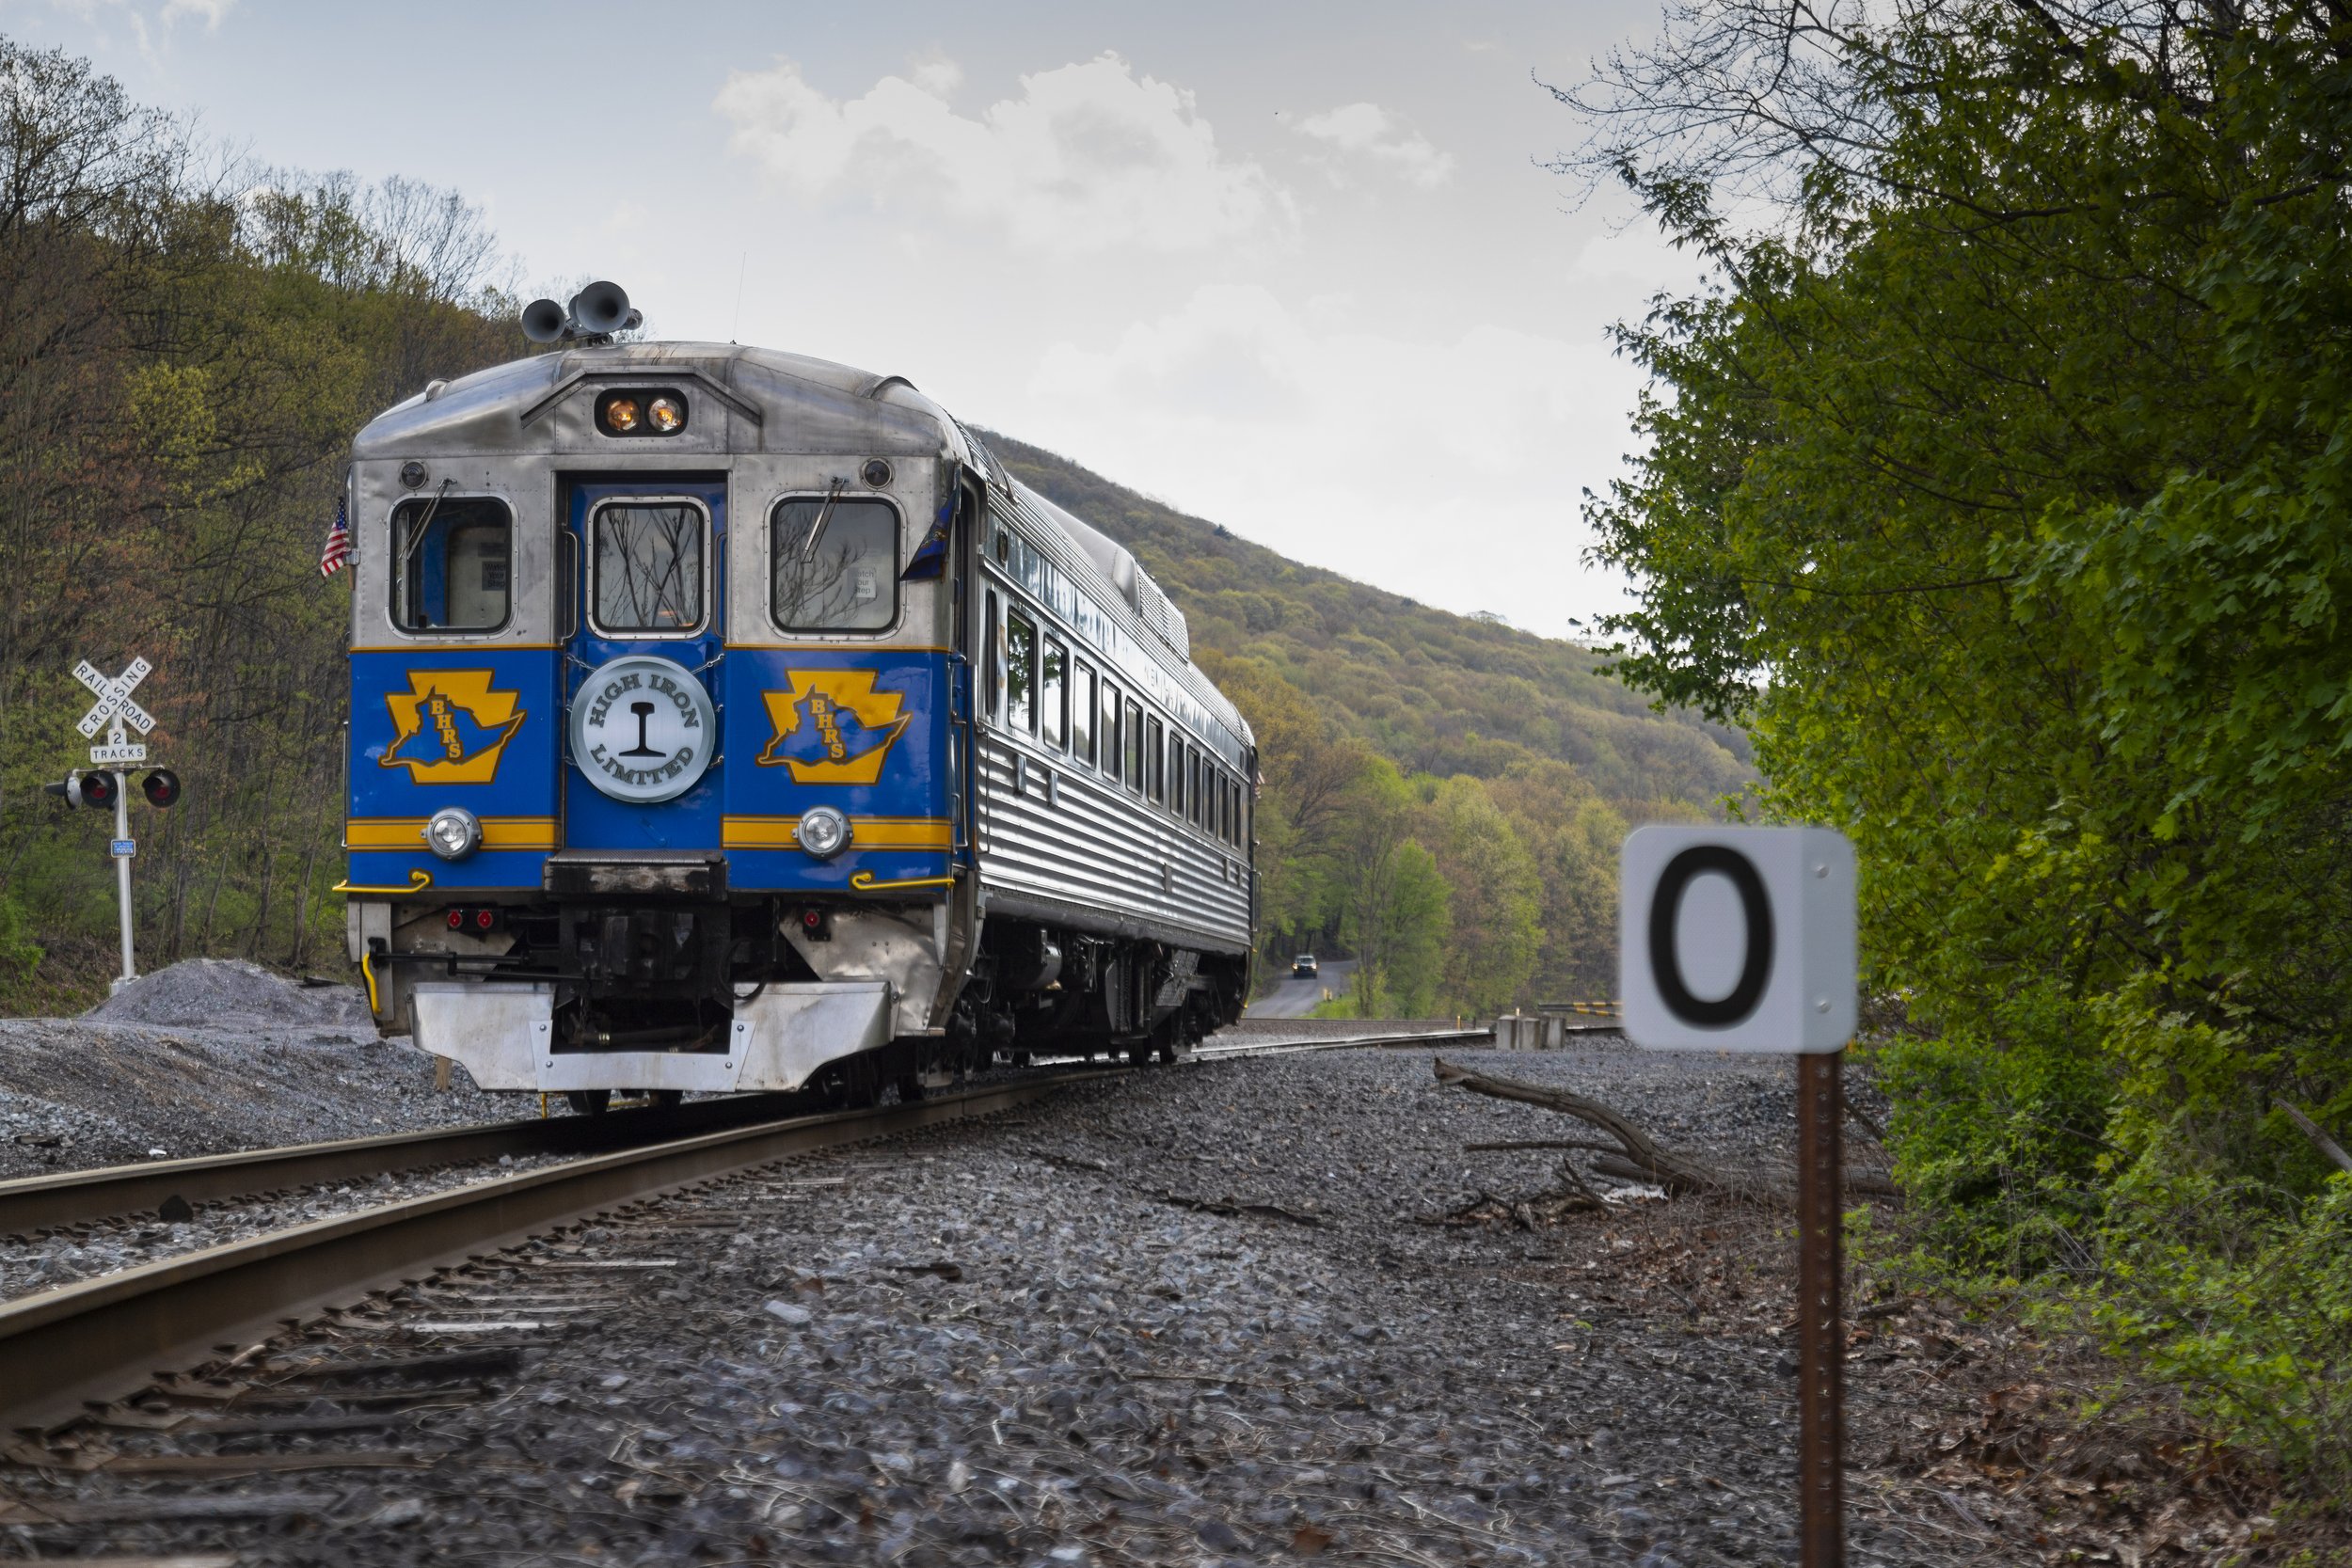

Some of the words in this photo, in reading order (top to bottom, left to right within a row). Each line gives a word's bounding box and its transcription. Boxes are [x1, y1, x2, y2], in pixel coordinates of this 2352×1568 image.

[76, 664, 107, 696] RAIL
[118, 700, 151, 730] ROAD
[81, 661, 148, 735] CROSSING
[589, 673, 643, 728] HIGH
[648, 674, 699, 728] IRON
[93, 748, 143, 759] TRACKS
[113, 733, 122, 744] 2
[590, 744, 694, 785] LIMITED
